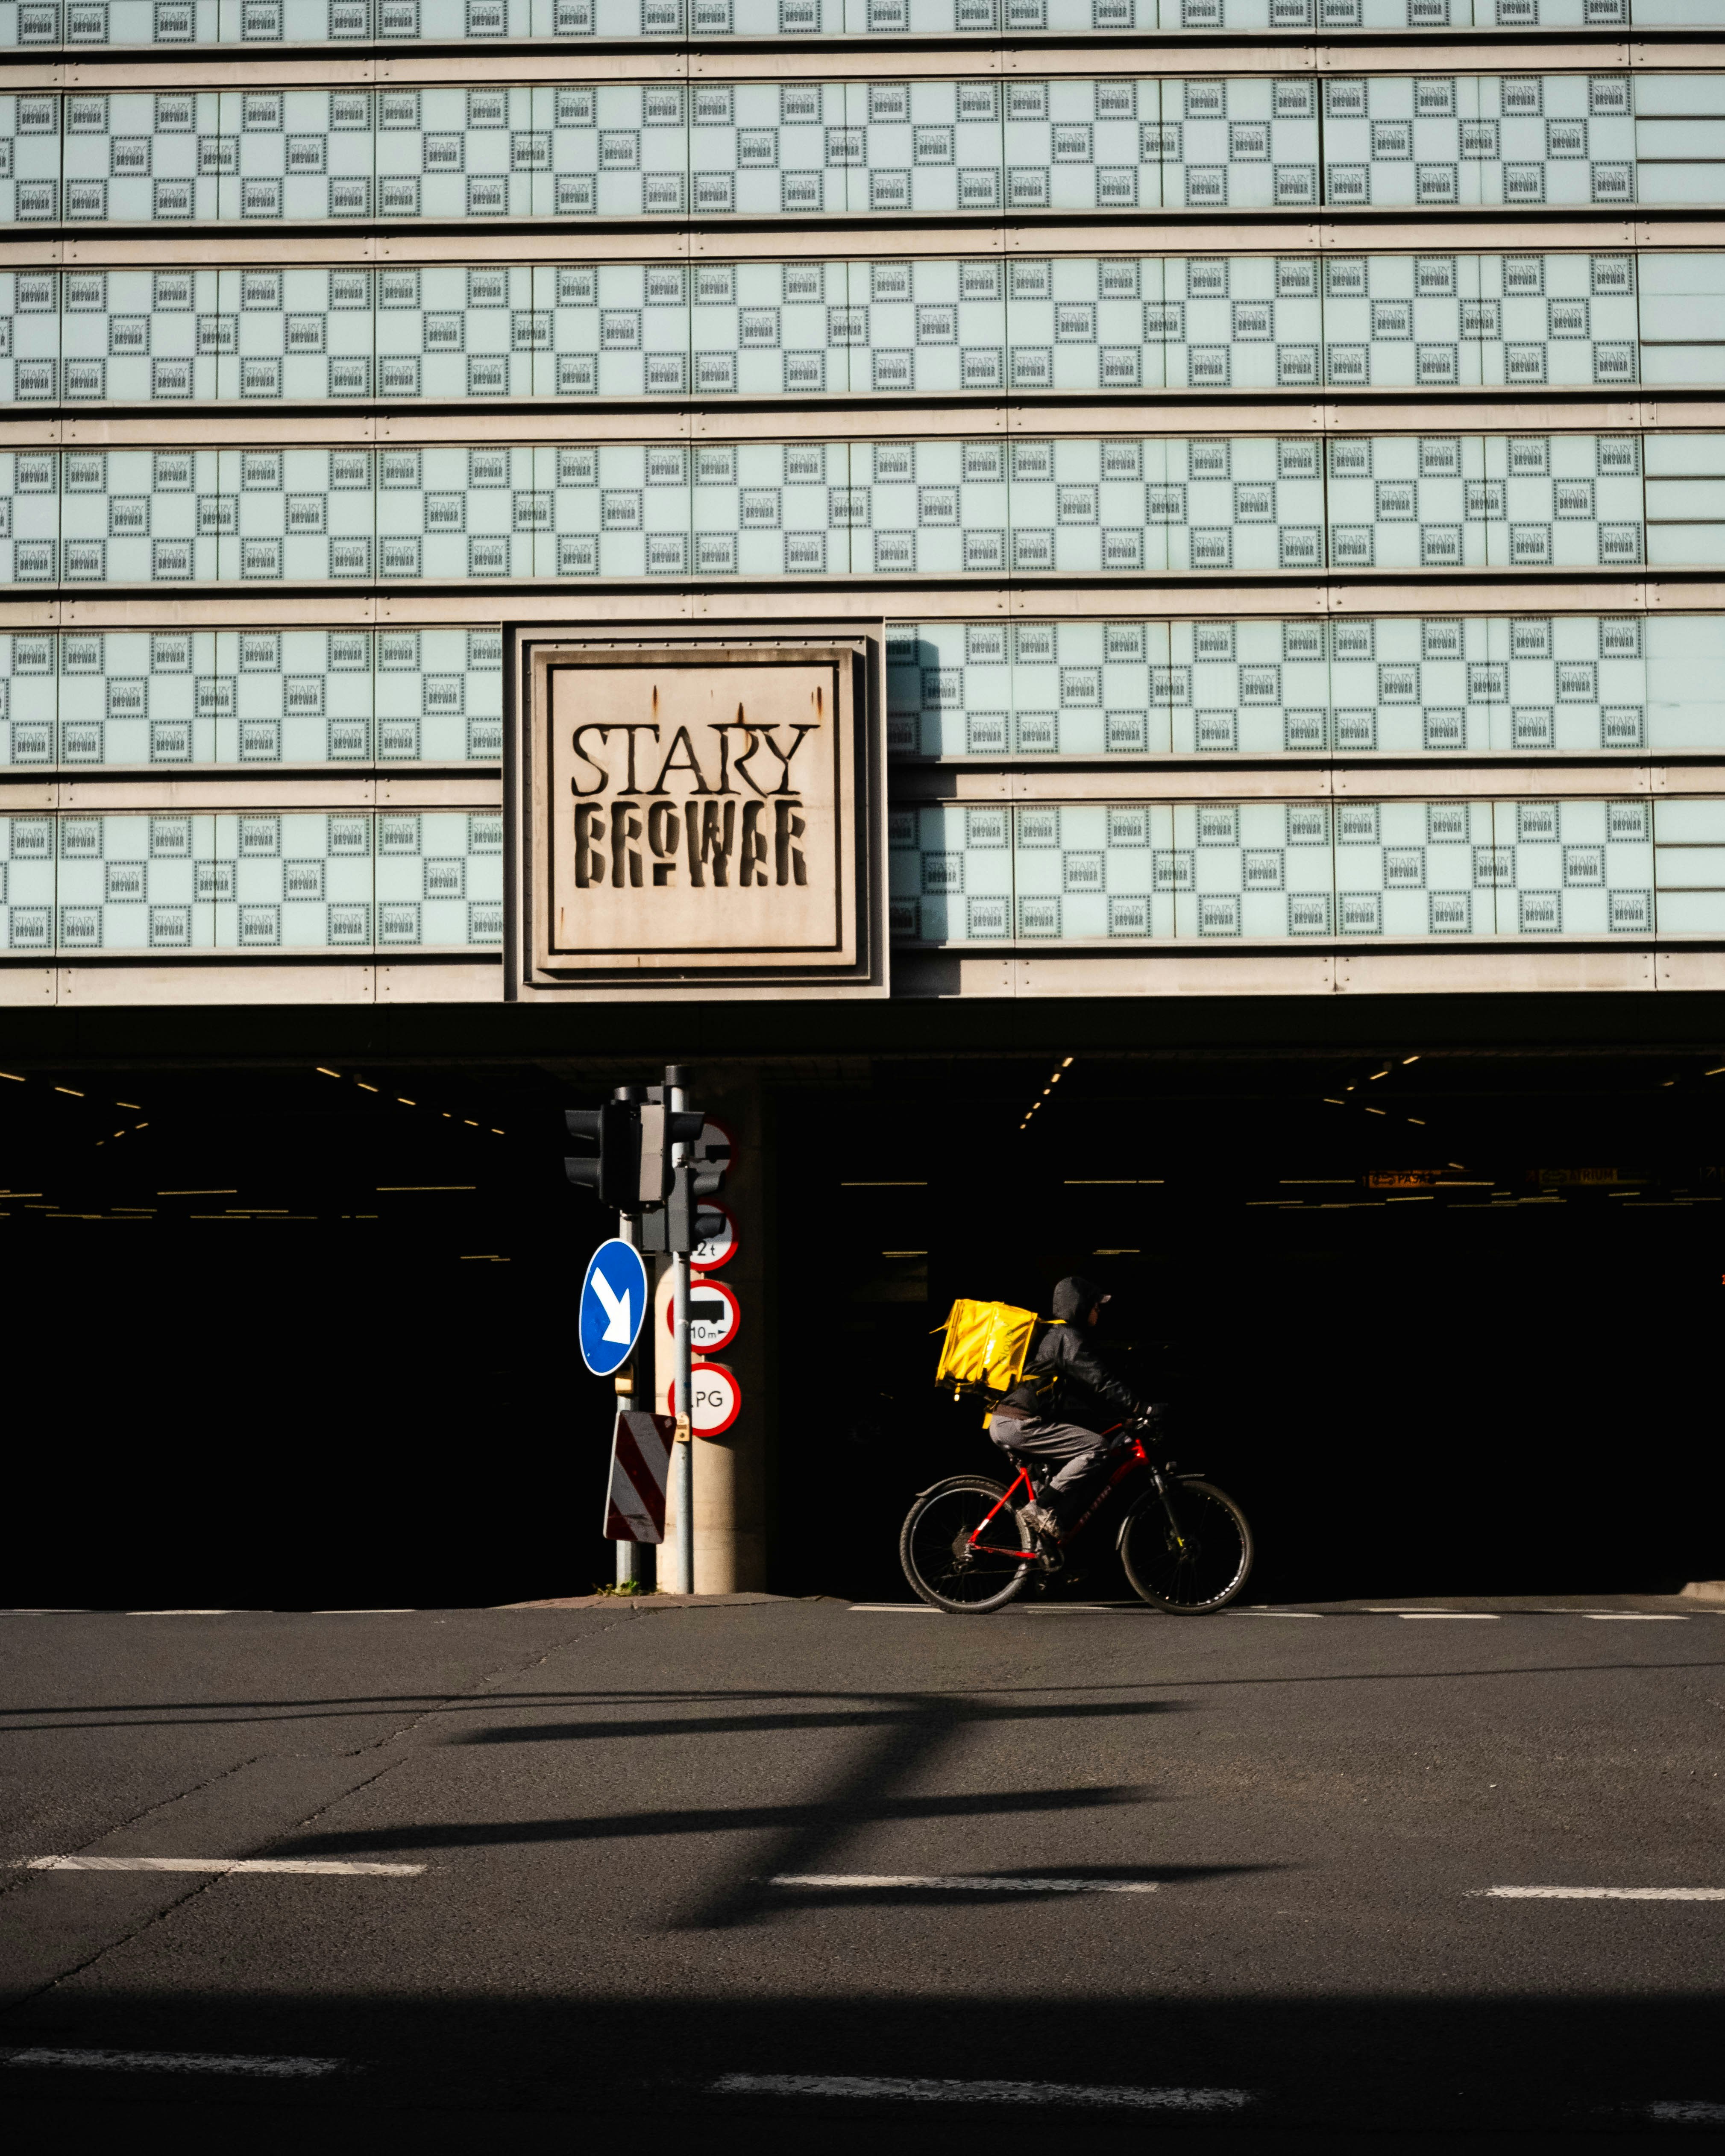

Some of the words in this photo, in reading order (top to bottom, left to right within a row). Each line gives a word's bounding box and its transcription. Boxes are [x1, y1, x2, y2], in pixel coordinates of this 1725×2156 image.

[25, 14, 53, 23] STARY
[161, 12, 189, 21] STARY
[24, 23, 52, 33] BROWAR
[160, 21, 188, 31] BROWAR
[473, 99, 502, 108] STARY
[649, 96, 678, 105] STARY
[473, 108, 501, 118] BROWAR
[648, 105, 676, 116] BROWAR
[292, 144, 320, 153] STARY
[291, 153, 319, 164] BROWAR
[1103, 176, 1131, 185] STARY
[1192, 175, 1221, 184] STARY
[1280, 174, 1309, 183] STARY
[1423, 173, 1451, 182] STARY
[1598, 172, 1626, 181] STARY
[700, 182, 728, 190] STARY
[788, 180, 816, 189] STARY
[876, 179, 905, 188] STARY
[964, 178, 993, 187] STARY
[1422, 182, 1450, 193] BROWAR
[1597, 181, 1625, 191] BROWAR
[160, 188, 188, 197] STARY
[385, 186, 414, 195] STARY
[473, 185, 502, 193] STARY
[561, 184, 590, 193] STARY
[876, 188, 904, 199] BROWAR
[964, 187, 992, 197] BROWAR
[1102, 185, 1130, 196] BROWAR
[1192, 184, 1220, 194] BROWAR
[1280, 183, 1308, 194] BROWAR
[22, 190, 50, 199] STARY
[472, 193, 501, 204] BROWAR
[561, 193, 589, 203] BROWAR
[699, 190, 728, 201] BROWAR
[787, 189, 816, 200] BROWAR
[21, 199, 49, 210] BROWAR
[159, 197, 187, 208] BROWAR
[385, 195, 413, 205] BROWAR
[115, 325, 144, 334] STARY
[114, 334, 143, 344] BROWAR
[1018, 357, 1046, 366] STARY
[1106, 356, 1135, 365] STARY
[1195, 355, 1223, 364] STARY
[1334, 354, 1363, 363] STARY
[1423, 353, 1451, 362] STARY
[1511, 353, 1540, 362] STARY
[474, 364, 502, 373] STARY
[563, 363, 591, 372] STARY
[701, 362, 730, 371] STARY
[790, 360, 818, 369] STARY
[879, 359, 907, 368] STARY
[1334, 363, 1362, 373] BROWAR
[1422, 362, 1450, 373] BROWAR
[1511, 362, 1539, 372] BROWAR
[21, 369, 50, 378] STARY
[247, 367, 276, 376] STARY
[386, 366, 414, 375] STARY
[789, 369, 818, 380] BROWAR
[878, 368, 907, 378] BROWAR
[1017, 366, 1045, 376] BROWAR
[1106, 365, 1134, 375] BROWAR
[1194, 364, 1223, 375] BROWAR
[385, 375, 414, 385] BROWAR
[473, 373, 502, 384] BROWAR
[562, 372, 590, 383] BROWAR
[701, 371, 729, 381] BROWAR
[21, 378, 49, 389] BROWAR
[246, 376, 275, 387] BROWAR
[925, 496, 953, 505] STARY
[1063, 494, 1092, 503] STARY
[1382, 491, 1411, 500] STARY
[1063, 503, 1091, 514] BROWAR
[1382, 500, 1410, 510] BROWAR
[115, 506, 144, 515] STARY
[924, 505, 953, 516] BROWAR
[114, 515, 143, 525] BROWAR
[1197, 537, 1226, 546] STARY
[1605, 533, 1634, 542] STARY
[386, 546, 415, 555] STARY
[475, 545, 503, 554] STARY
[563, 544, 592, 553] STARY
[652, 543, 681, 552] STARY
[791, 542, 819, 551] STARY
[1197, 546, 1225, 557] BROWAR
[1605, 542, 1633, 552] BROWAR
[20, 551, 49, 560] STARY
[247, 548, 276, 557] STARY
[652, 552, 680, 563] BROWAR
[790, 551, 818, 561] BROWAR
[247, 557, 275, 568] BROWAR
[386, 555, 414, 566] BROWAR
[474, 554, 502, 565] BROWAR
[563, 553, 591, 564] BROWAR
[20, 560, 48, 570] BROWAR
[1066, 677, 1096, 686] STARY
[1385, 673, 1414, 683] STARY
[113, 687, 141, 696] STARY
[429, 684, 458, 693] STARY
[1066, 686, 1094, 697] BROWAR
[1384, 683, 1413, 694] BROWAR
[112, 696, 141, 707] BROWAR
[429, 693, 457, 703] BROWAR
[1202, 719, 1231, 729] STARY
[1291, 718, 1320, 728] STARY
[1608, 716, 1637, 725] STARY
[973, 722, 1003, 731] STARY
[1607, 725, 1636, 736] BROWAR
[18, 732, 47, 741] STARY
[246, 730, 274, 739] STARY
[334, 729, 363, 738] STARY
[973, 731, 1001, 742] BROWAR
[1201, 729, 1230, 740] BROWAR
[1291, 728, 1319, 739] BROWAR
[18, 741, 46, 752] BROWAR
[245, 739, 273, 750] BROWAR
[333, 738, 362, 749] BROWAR
[571, 723, 820, 798] STARY
[156, 827, 185, 836] STARY
[245, 826, 274, 835] STARY
[334, 825, 363, 834] STARY
[156, 836, 184, 847] BROWAR
[245, 835, 273, 846] BROWAR
[333, 834, 362, 845] BROWAR
[574, 800, 809, 888] BROWAR
[1069, 861, 1099, 870] STARY
[1069, 870, 1097, 882] BROWAR
[1205, 905, 1234, 914] STARY
[1346, 902, 1375, 912] STARY
[1526, 900, 1555, 910] STARY
[974, 906, 1003, 916] STARY
[1525, 910, 1554, 921] BROWAR
[16, 917, 44, 926] STARY
[155, 915, 185, 925] STARY
[245, 914, 274, 924] STARY
[385, 913, 414, 922] STARY
[973, 916, 1002, 927] BROWAR
[1204, 914, 1233, 925] BROWAR
[1345, 912, 1374, 923] BROWAR
[15, 926, 44, 937] BROWAR
[155, 925, 183, 936] BROWAR
[244, 924, 273, 935] BROWAR
[384, 922, 413, 933] BROWAR
[710, 1244, 715, 1256] t
[690, 1327, 706, 1339] 10
[692, 1391, 723, 1407] PG
